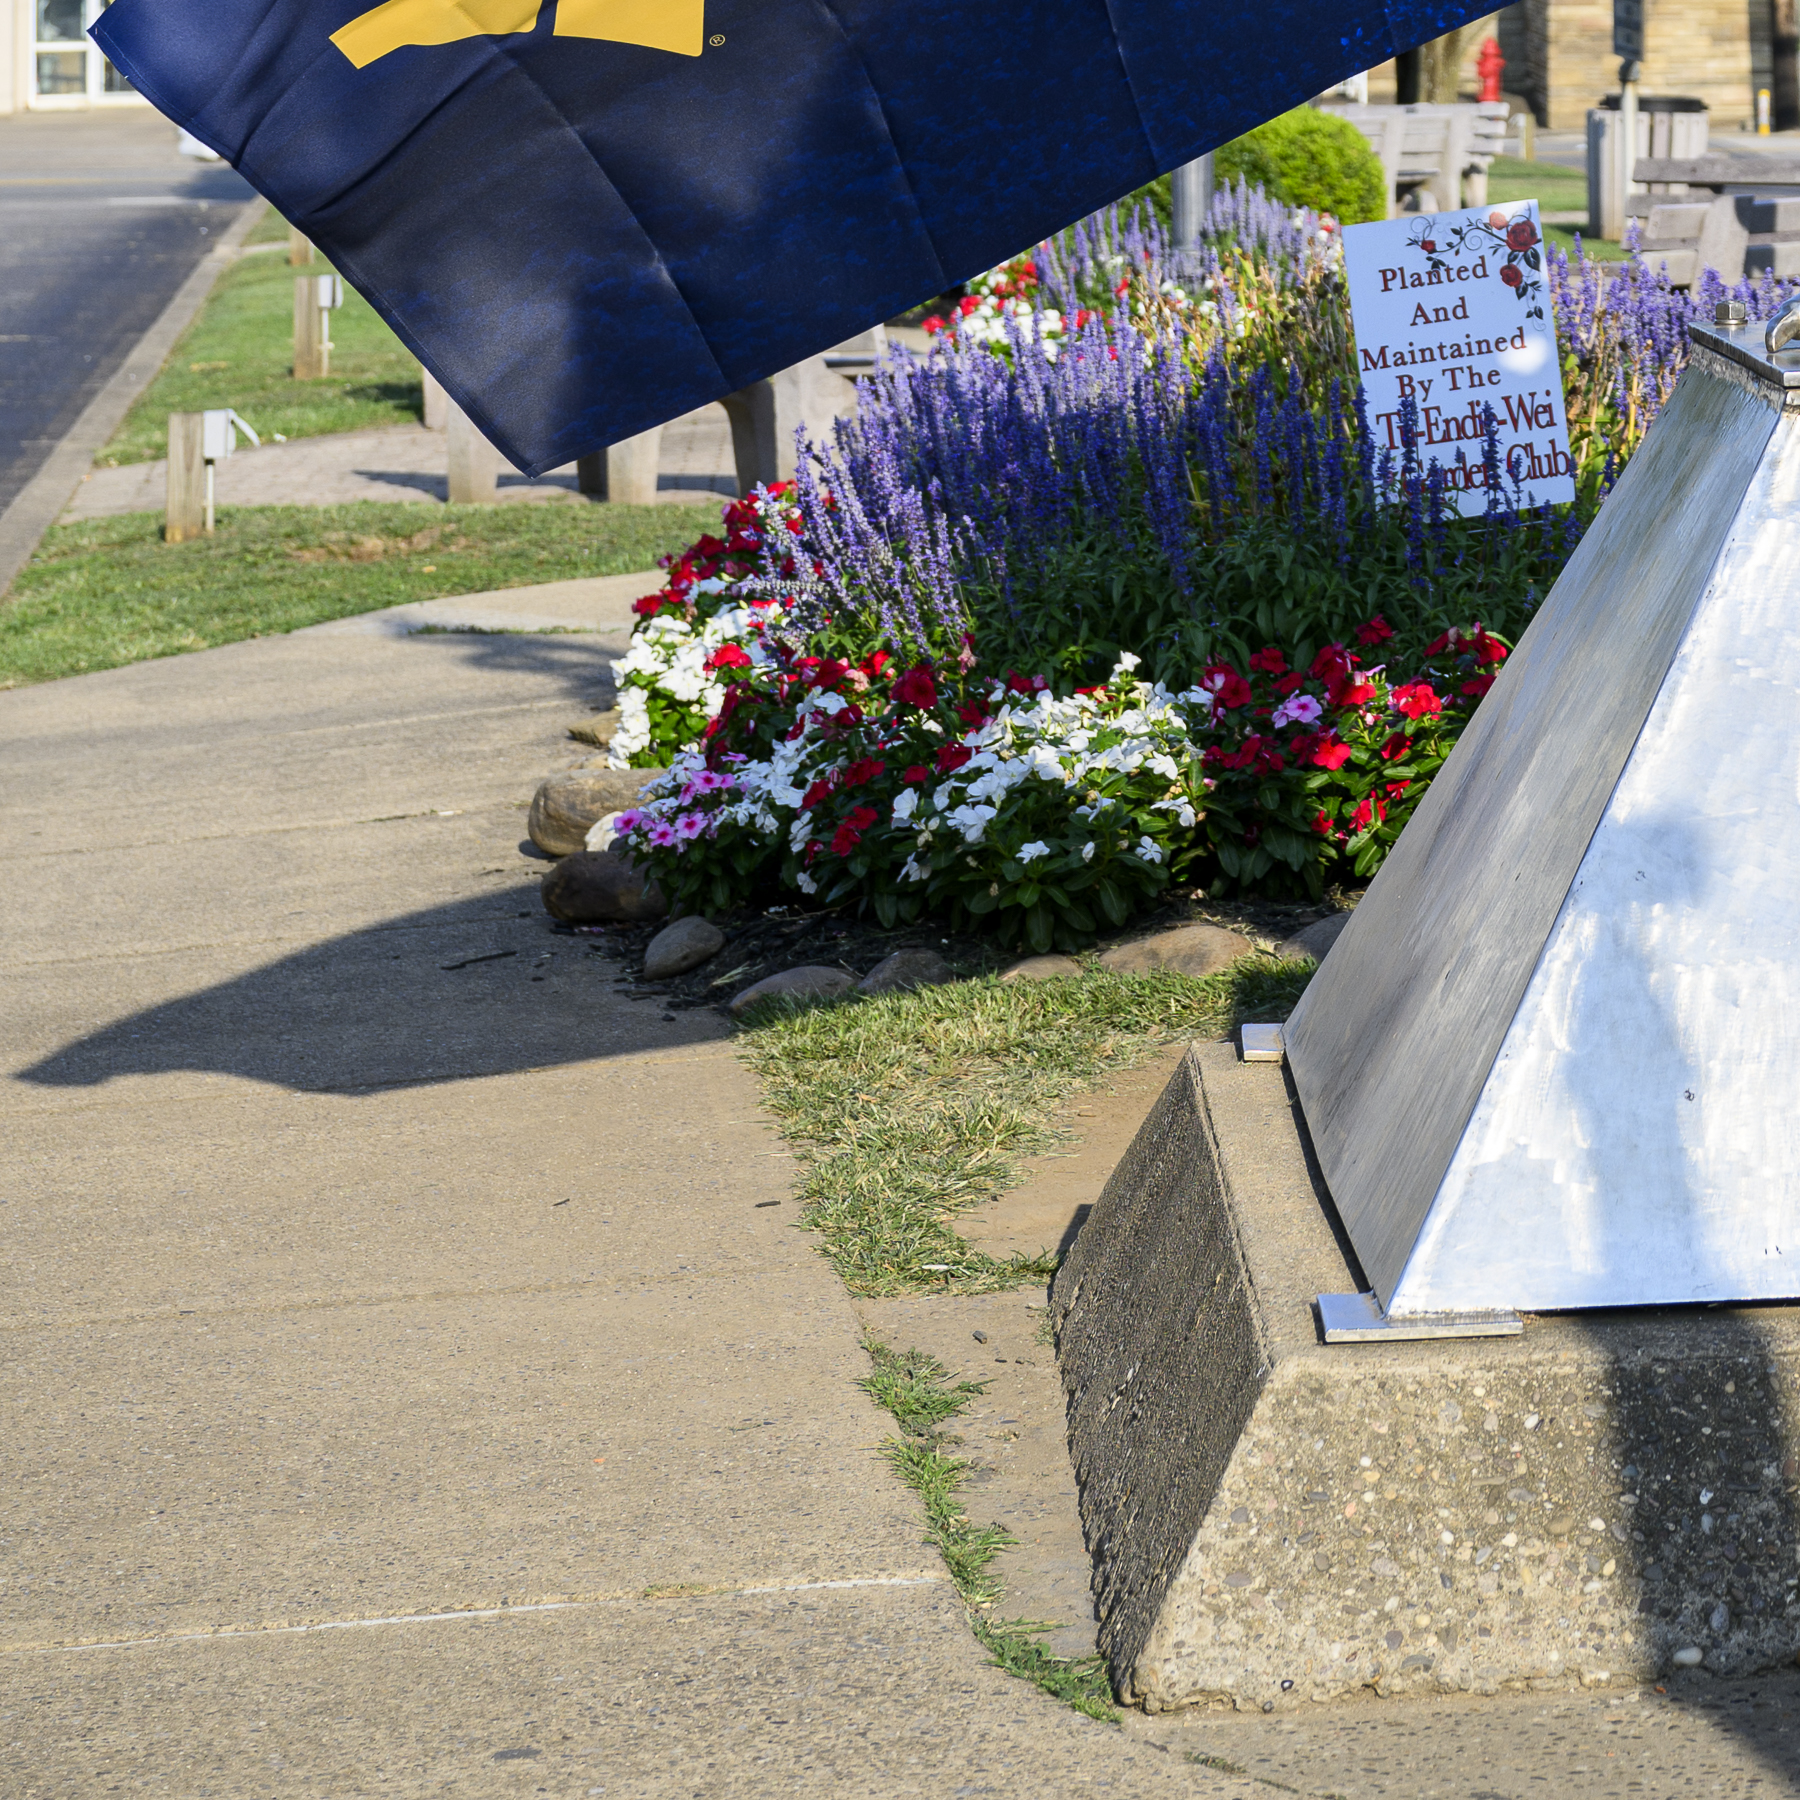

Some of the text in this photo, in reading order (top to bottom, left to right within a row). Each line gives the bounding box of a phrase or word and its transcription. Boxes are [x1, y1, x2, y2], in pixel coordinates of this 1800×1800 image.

[1378, 255, 1490, 293] Planted
[1409, 296, 1470, 327] And
[1360, 326, 1527, 372] Maintained
[1396, 365, 1502, 402] By The
[1505, 438, 1571, 484] Club
